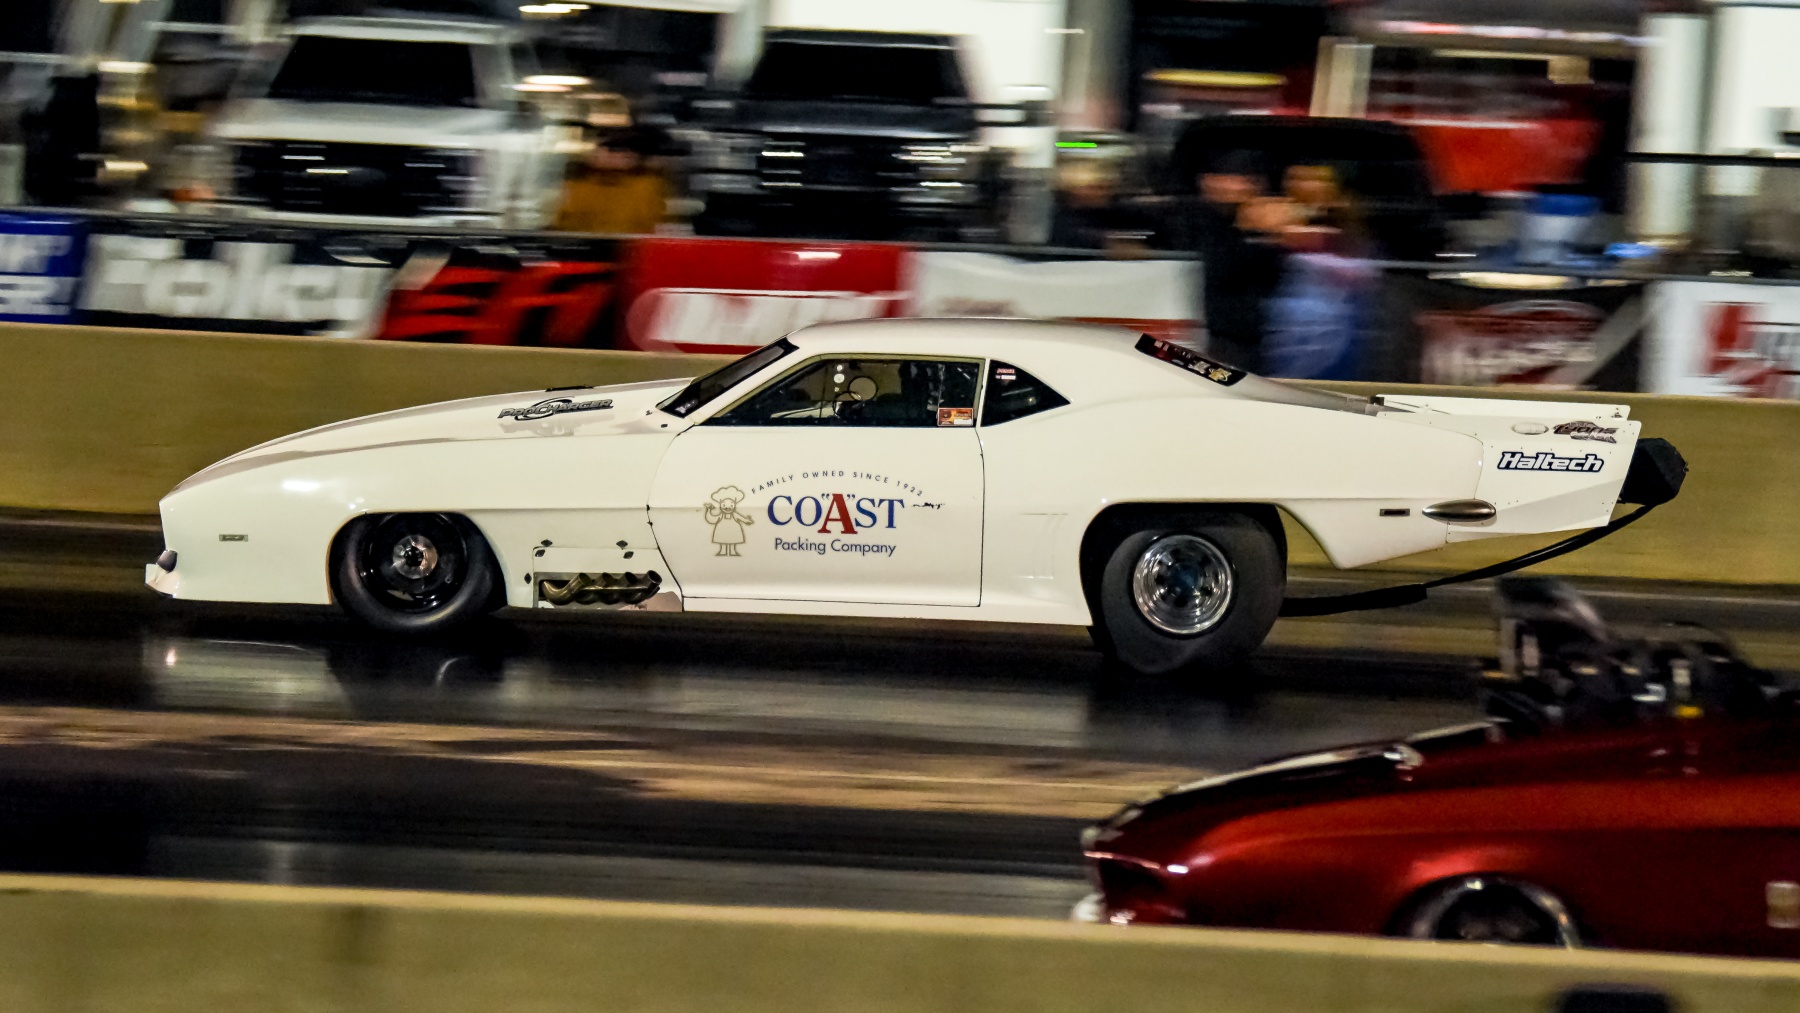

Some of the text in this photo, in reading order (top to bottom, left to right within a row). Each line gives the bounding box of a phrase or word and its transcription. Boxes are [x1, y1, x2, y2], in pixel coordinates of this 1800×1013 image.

[1497, 451, 1604, 472] Haltech
[751, 470, 923, 497] FAMILY OWNED SINCE 1922
[774, 537, 897, 558] Packing Company
